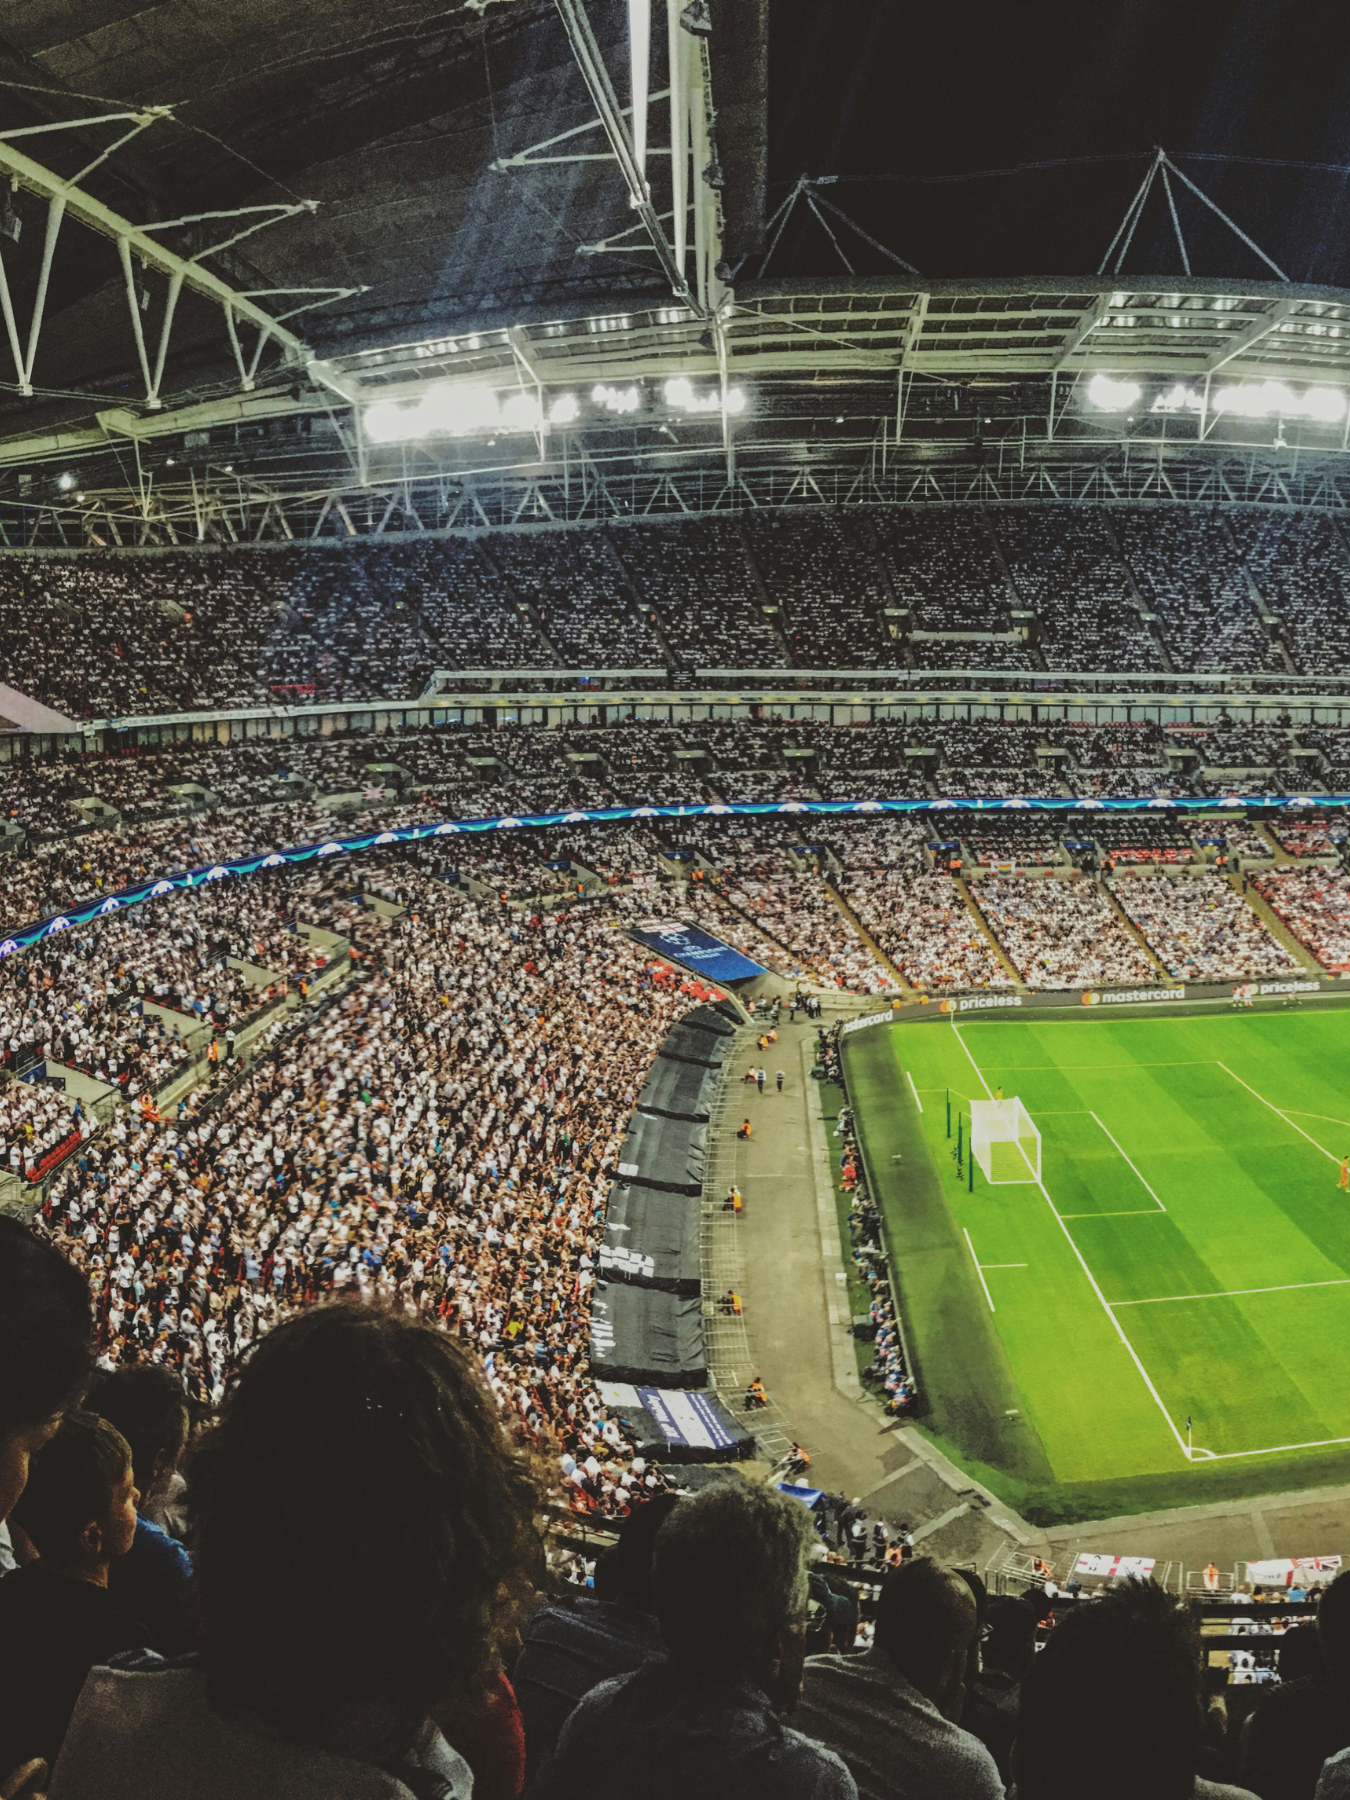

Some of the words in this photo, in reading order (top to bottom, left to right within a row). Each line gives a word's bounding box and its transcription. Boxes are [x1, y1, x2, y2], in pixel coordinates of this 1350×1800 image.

[1102, 988, 1185, 1003] mastercard
[1260, 981, 1321, 995] priceless
[960, 995, 1022, 1011] priceless
[843, 1009, 893, 1033] astercard
